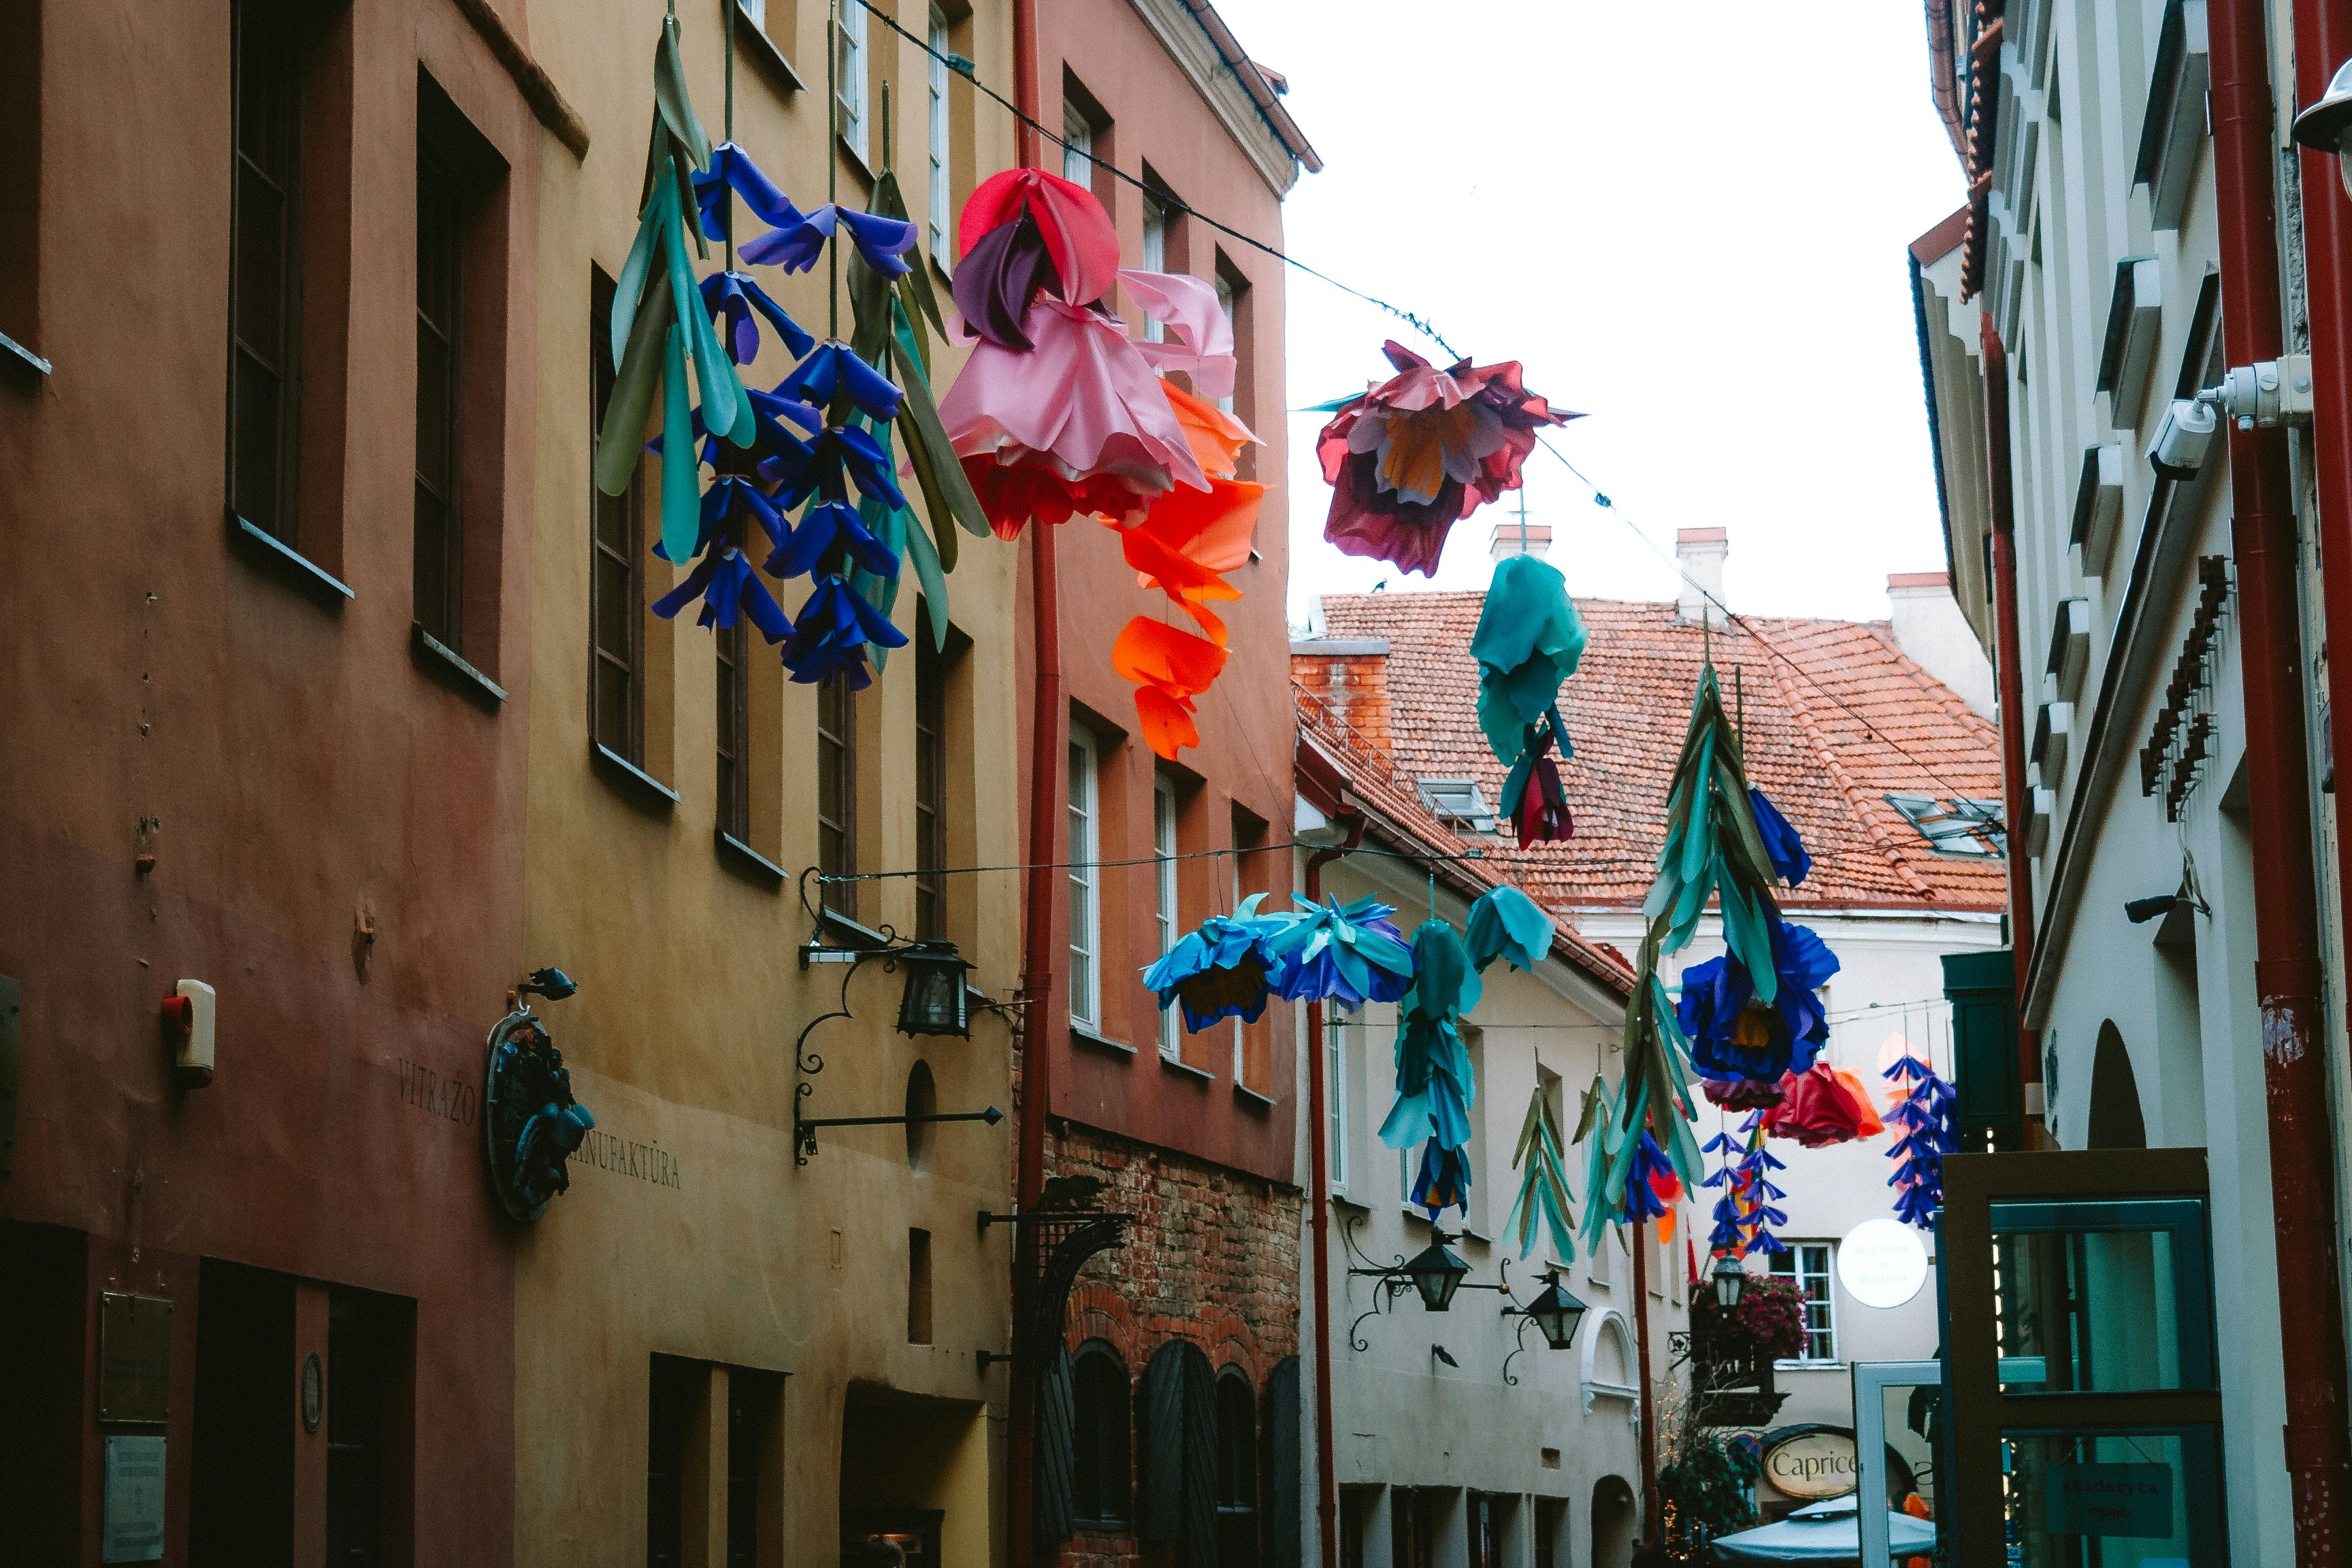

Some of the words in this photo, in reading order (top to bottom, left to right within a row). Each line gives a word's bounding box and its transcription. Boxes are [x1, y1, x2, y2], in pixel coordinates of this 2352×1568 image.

[399, 1058, 475, 1127] VITRAŽO
[568, 1130, 681, 1190] NUFAKTŪRA
[1855, 1245, 1909, 1257] Augustas
[1878, 1259, 1887, 1269] ir
[1859, 1273, 1907, 1284] Barbora
[1773, 1451, 1857, 1482] Caprice
[2088, 1507, 2131, 1520] open
